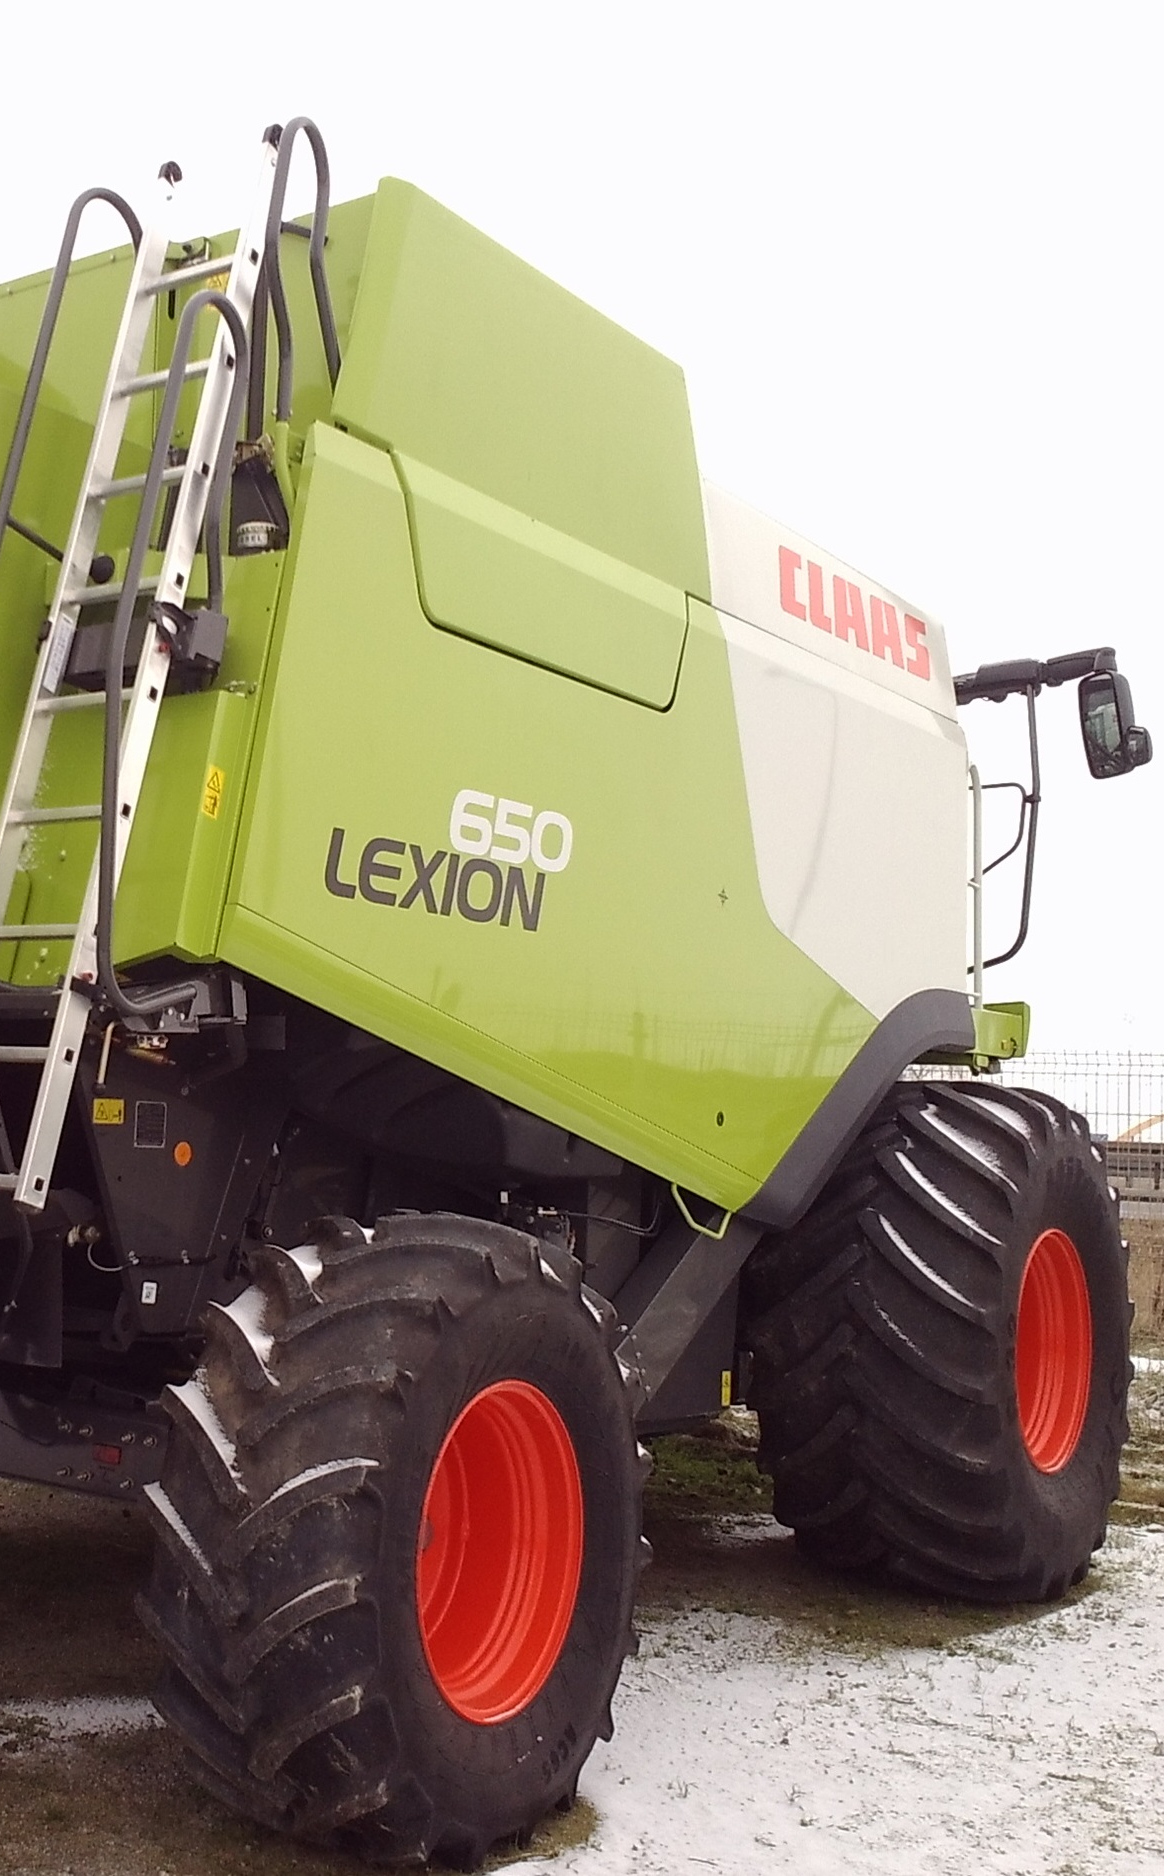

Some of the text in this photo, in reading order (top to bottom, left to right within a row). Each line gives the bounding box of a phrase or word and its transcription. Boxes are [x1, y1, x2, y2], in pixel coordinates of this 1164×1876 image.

[778, 545, 930, 681] CLAAS
[324, 827, 546, 932] LEXION
[449, 789, 573, 872] 650
